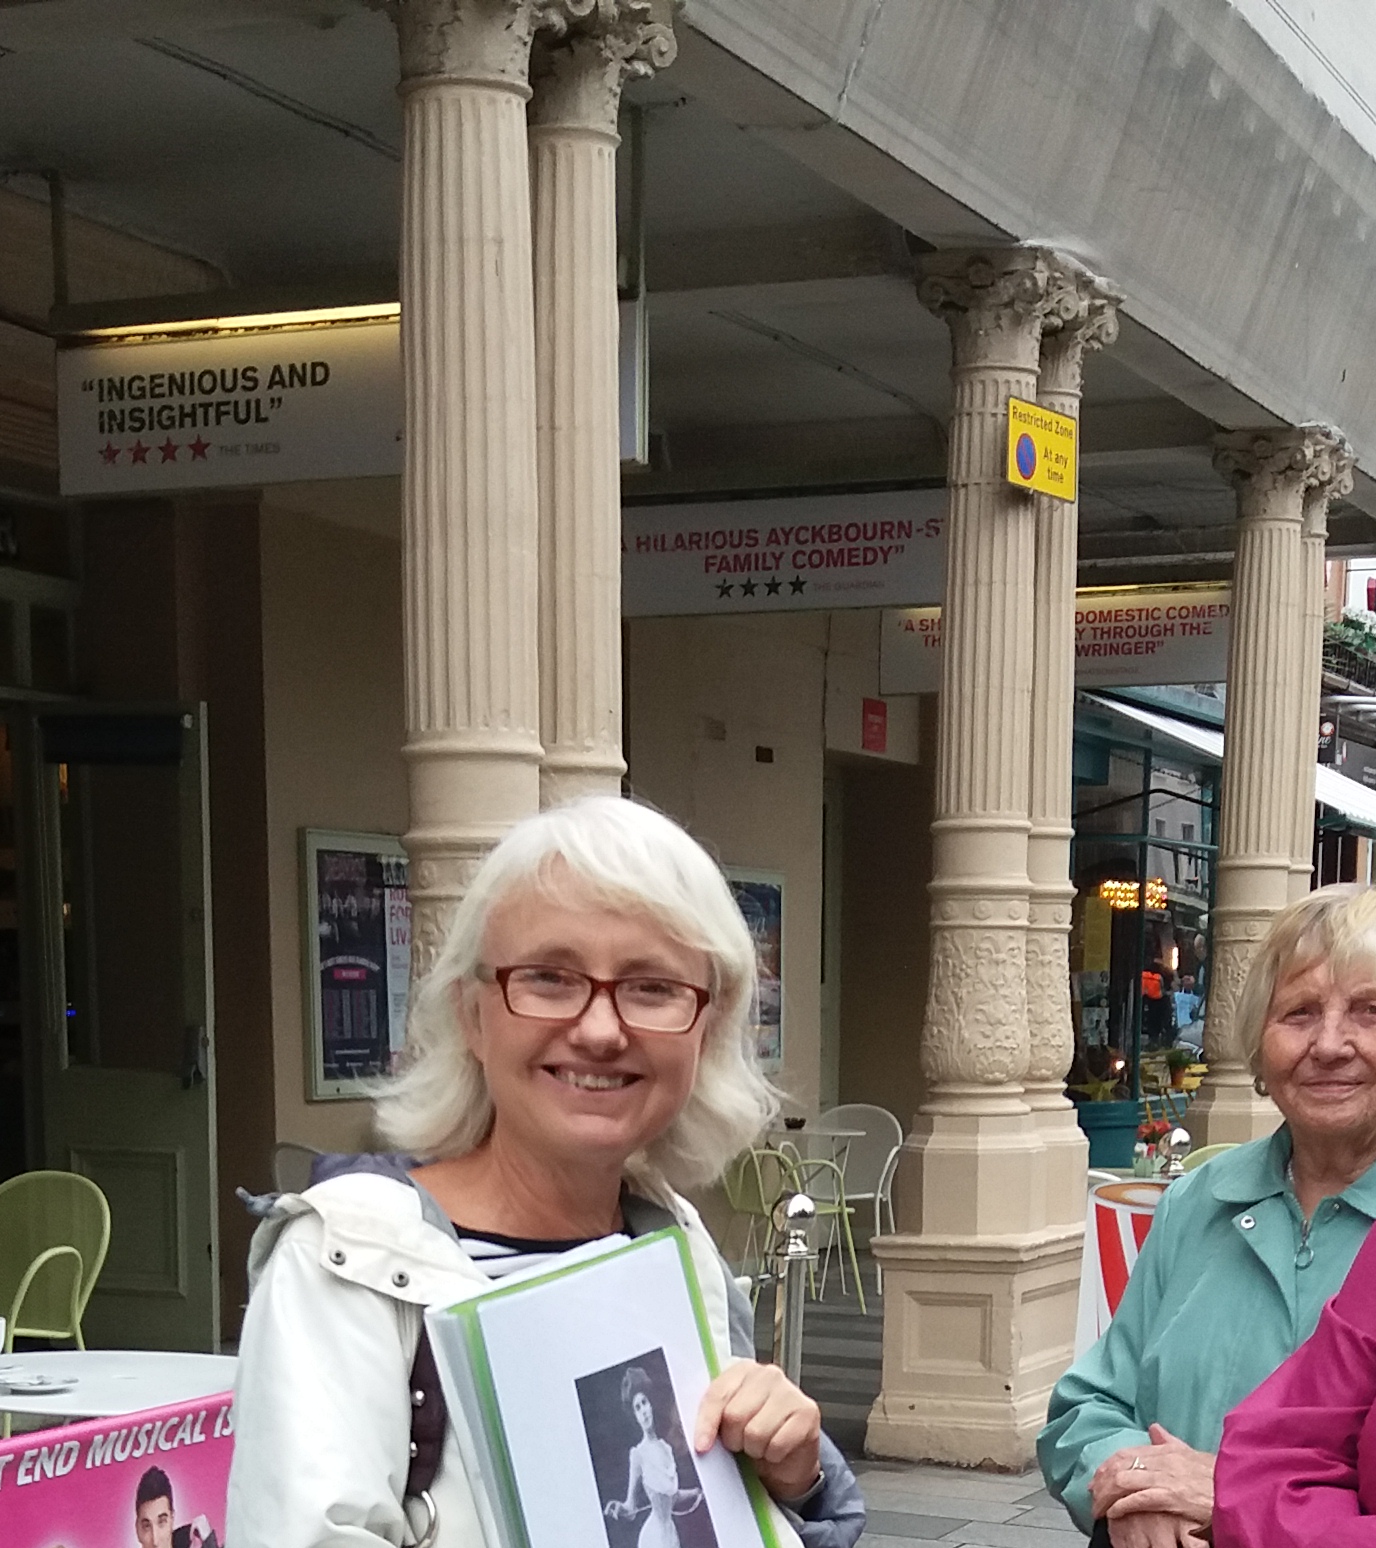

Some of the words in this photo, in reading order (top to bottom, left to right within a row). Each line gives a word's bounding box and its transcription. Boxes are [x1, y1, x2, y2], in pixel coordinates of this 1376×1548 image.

[81, 365, 260, 404] “INGENIOUS
[267, 360, 332, 391] AND
[98, 396, 284, 435] INSIGHTFUL”
[1012, 405, 1053, 432] Restricted
[1054, 421, 1074, 440] Zone
[218, 445, 241, 457] THE
[245, 441, 281, 456] TIMES
[1043, 446, 1053, 462] At
[1054, 452, 1069, 469] any
[1047, 467, 1064, 484] time
[635, 527, 760, 554] HILARIOUS
[766, 518, 944, 548] AYCKBOURN-S
[704, 550, 785, 575] FAMILY
[792, 544, 906, 570] COMEDY”
[1075, 607, 1162, 625] DOMESTIC
[1091, 623, 1175, 640] THROUGH
[1180, 622, 1213, 637] THE
[17, 1438, 81, 1487] END
[85, 1416, 208, 1470] MUSICAL
